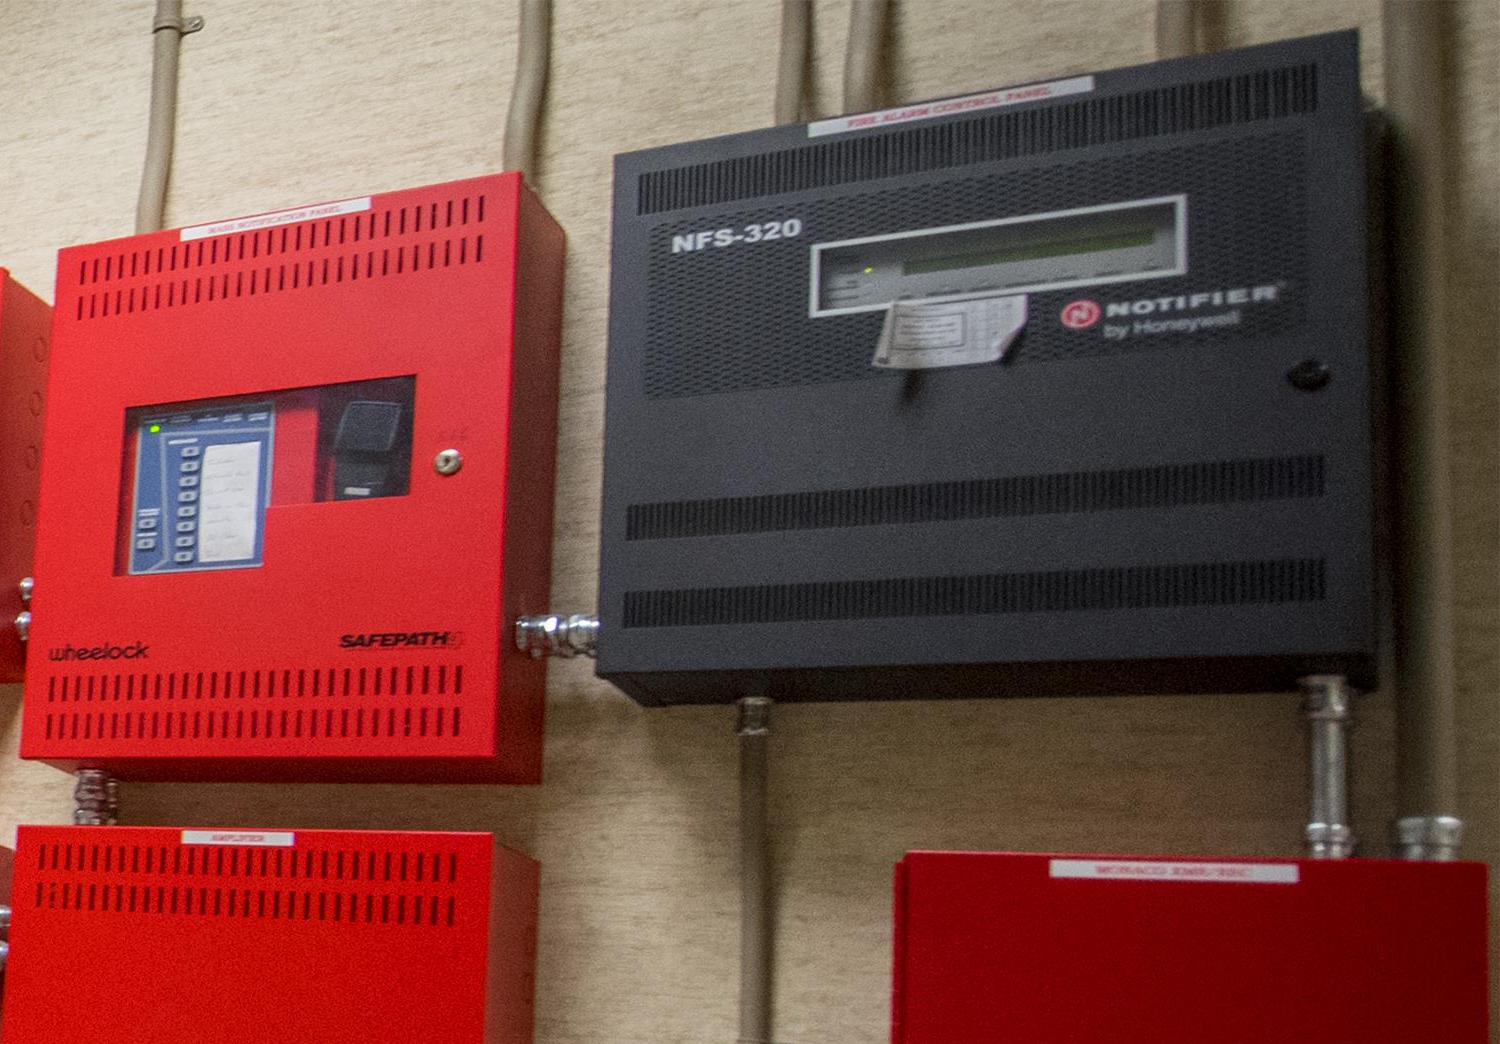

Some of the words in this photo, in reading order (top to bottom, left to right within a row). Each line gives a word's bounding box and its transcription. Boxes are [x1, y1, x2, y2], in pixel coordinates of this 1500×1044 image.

[882, 108, 930, 123] ALARM
[932, 96, 998, 114] CONTROL
[671, 218, 802, 254] NFS-320
[1106, 286, 1278, 317] NOTIFIER
[1103, 324, 1130, 340] by
[1133, 310, 1241, 334] Honeywell
[49, 641, 149, 661] wheelock
[340, 631, 451, 648] SAFEPATH
